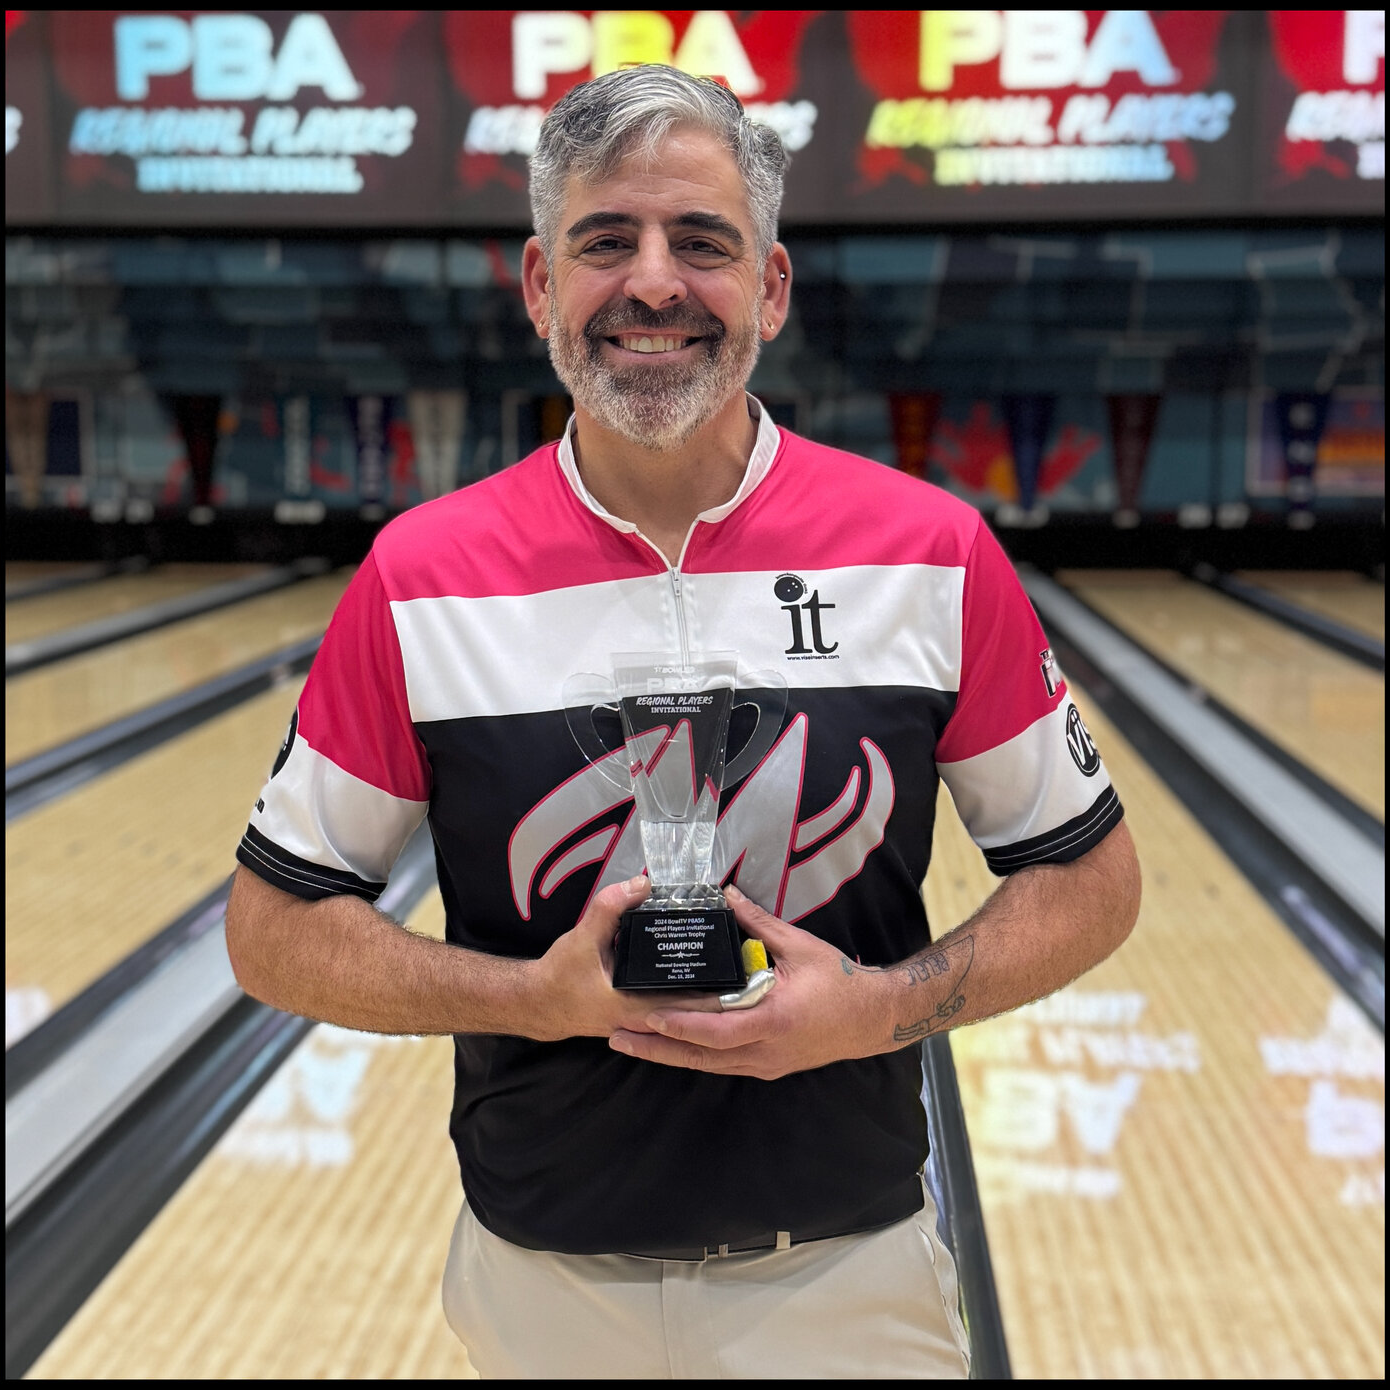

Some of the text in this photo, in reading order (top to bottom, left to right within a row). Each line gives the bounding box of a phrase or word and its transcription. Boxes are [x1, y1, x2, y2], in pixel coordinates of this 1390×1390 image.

[115, 13, 360, 101] PBA
[513, 11, 764, 99] PBA
[919, 11, 1178, 91] PBA
[774, 577, 839, 654] it
[636, 696, 713, 706] REGIONAL PLAYERS
[657, 942, 703, 951] CHAMPION
[688, 931, 705, 939] Trophy
